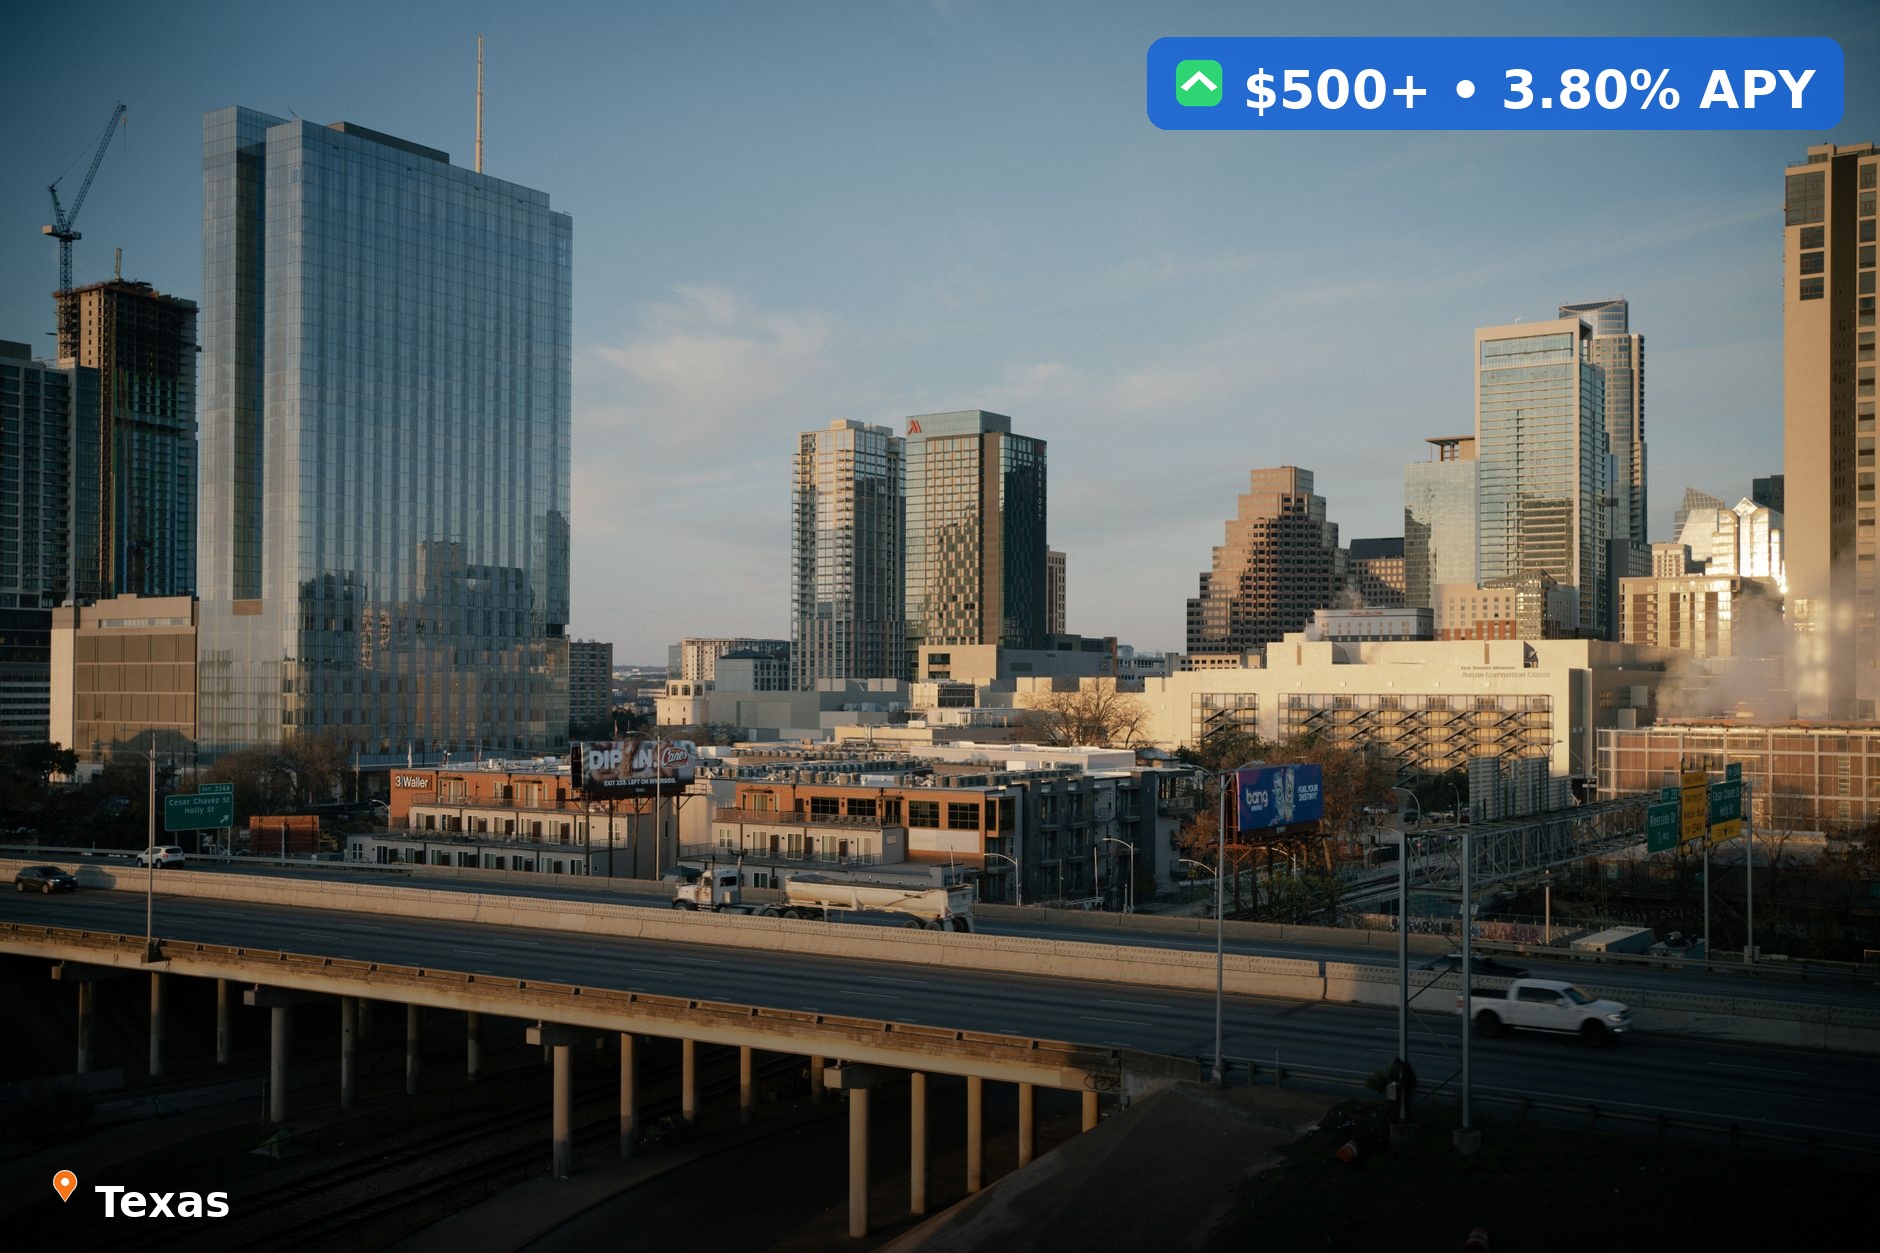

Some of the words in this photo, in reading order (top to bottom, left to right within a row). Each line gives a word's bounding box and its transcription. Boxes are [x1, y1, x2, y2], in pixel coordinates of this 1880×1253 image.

[589, 749, 622, 771] DIP
[661, 747, 689, 768] Cane's
[214, 784, 231, 792] 234A
[193, 797, 219, 805] Chavez
[1245, 788, 1268, 808] bang
[184, 806, 204, 815] Holly
[206, 805, 215, 813] St
